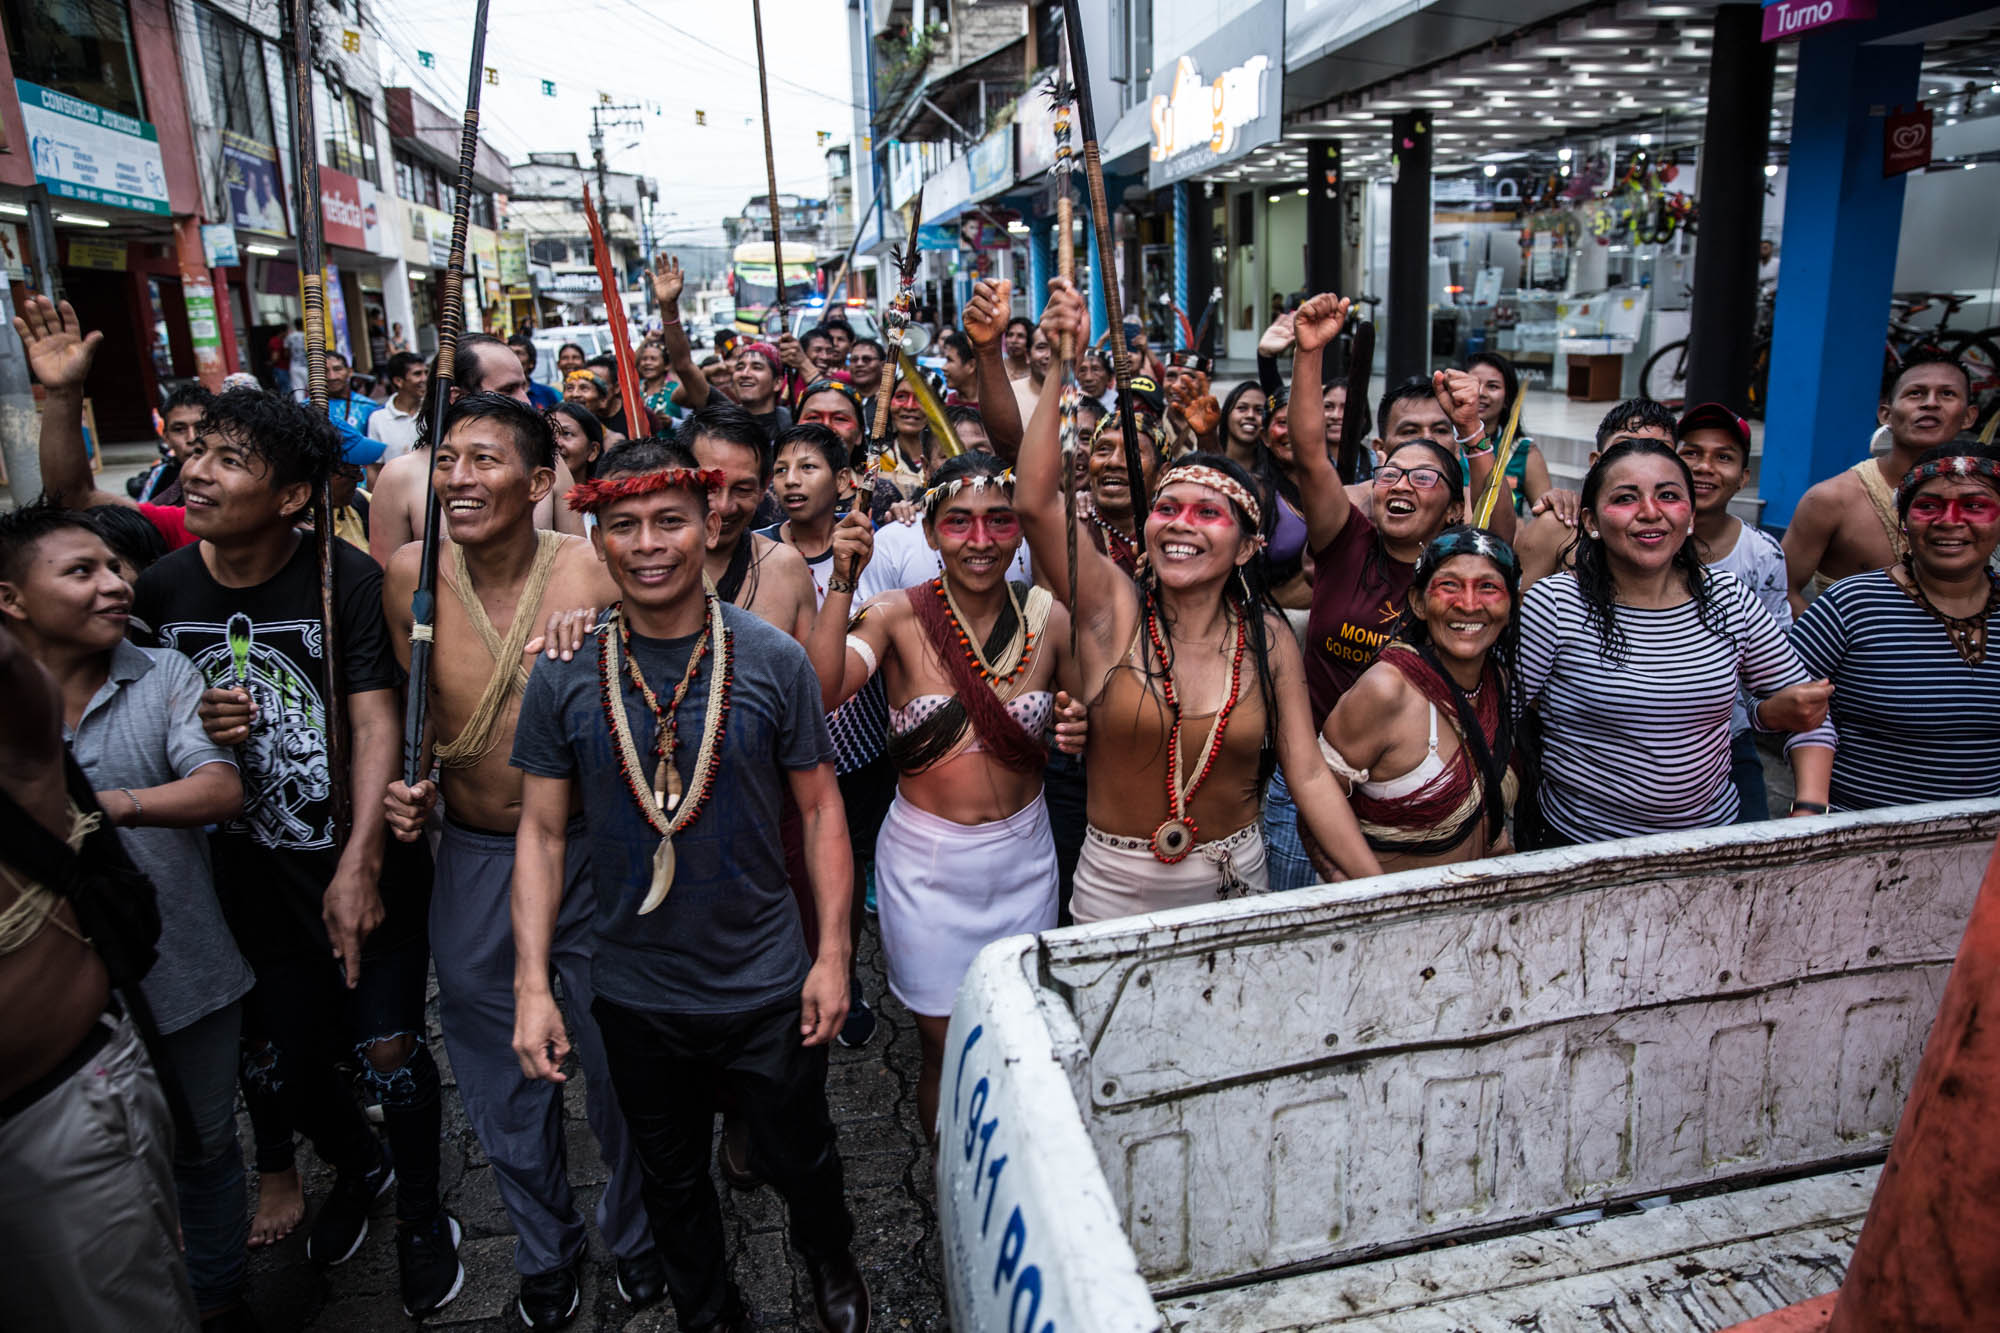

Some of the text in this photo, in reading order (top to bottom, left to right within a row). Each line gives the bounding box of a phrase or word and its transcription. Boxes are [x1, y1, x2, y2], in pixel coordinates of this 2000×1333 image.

[1777, 1, 1833, 32] Turno
[1341, 622, 1400, 647] MONIT
[1326, 636, 1371, 664] GORON
[994, 1202, 1055, 1333] PO
